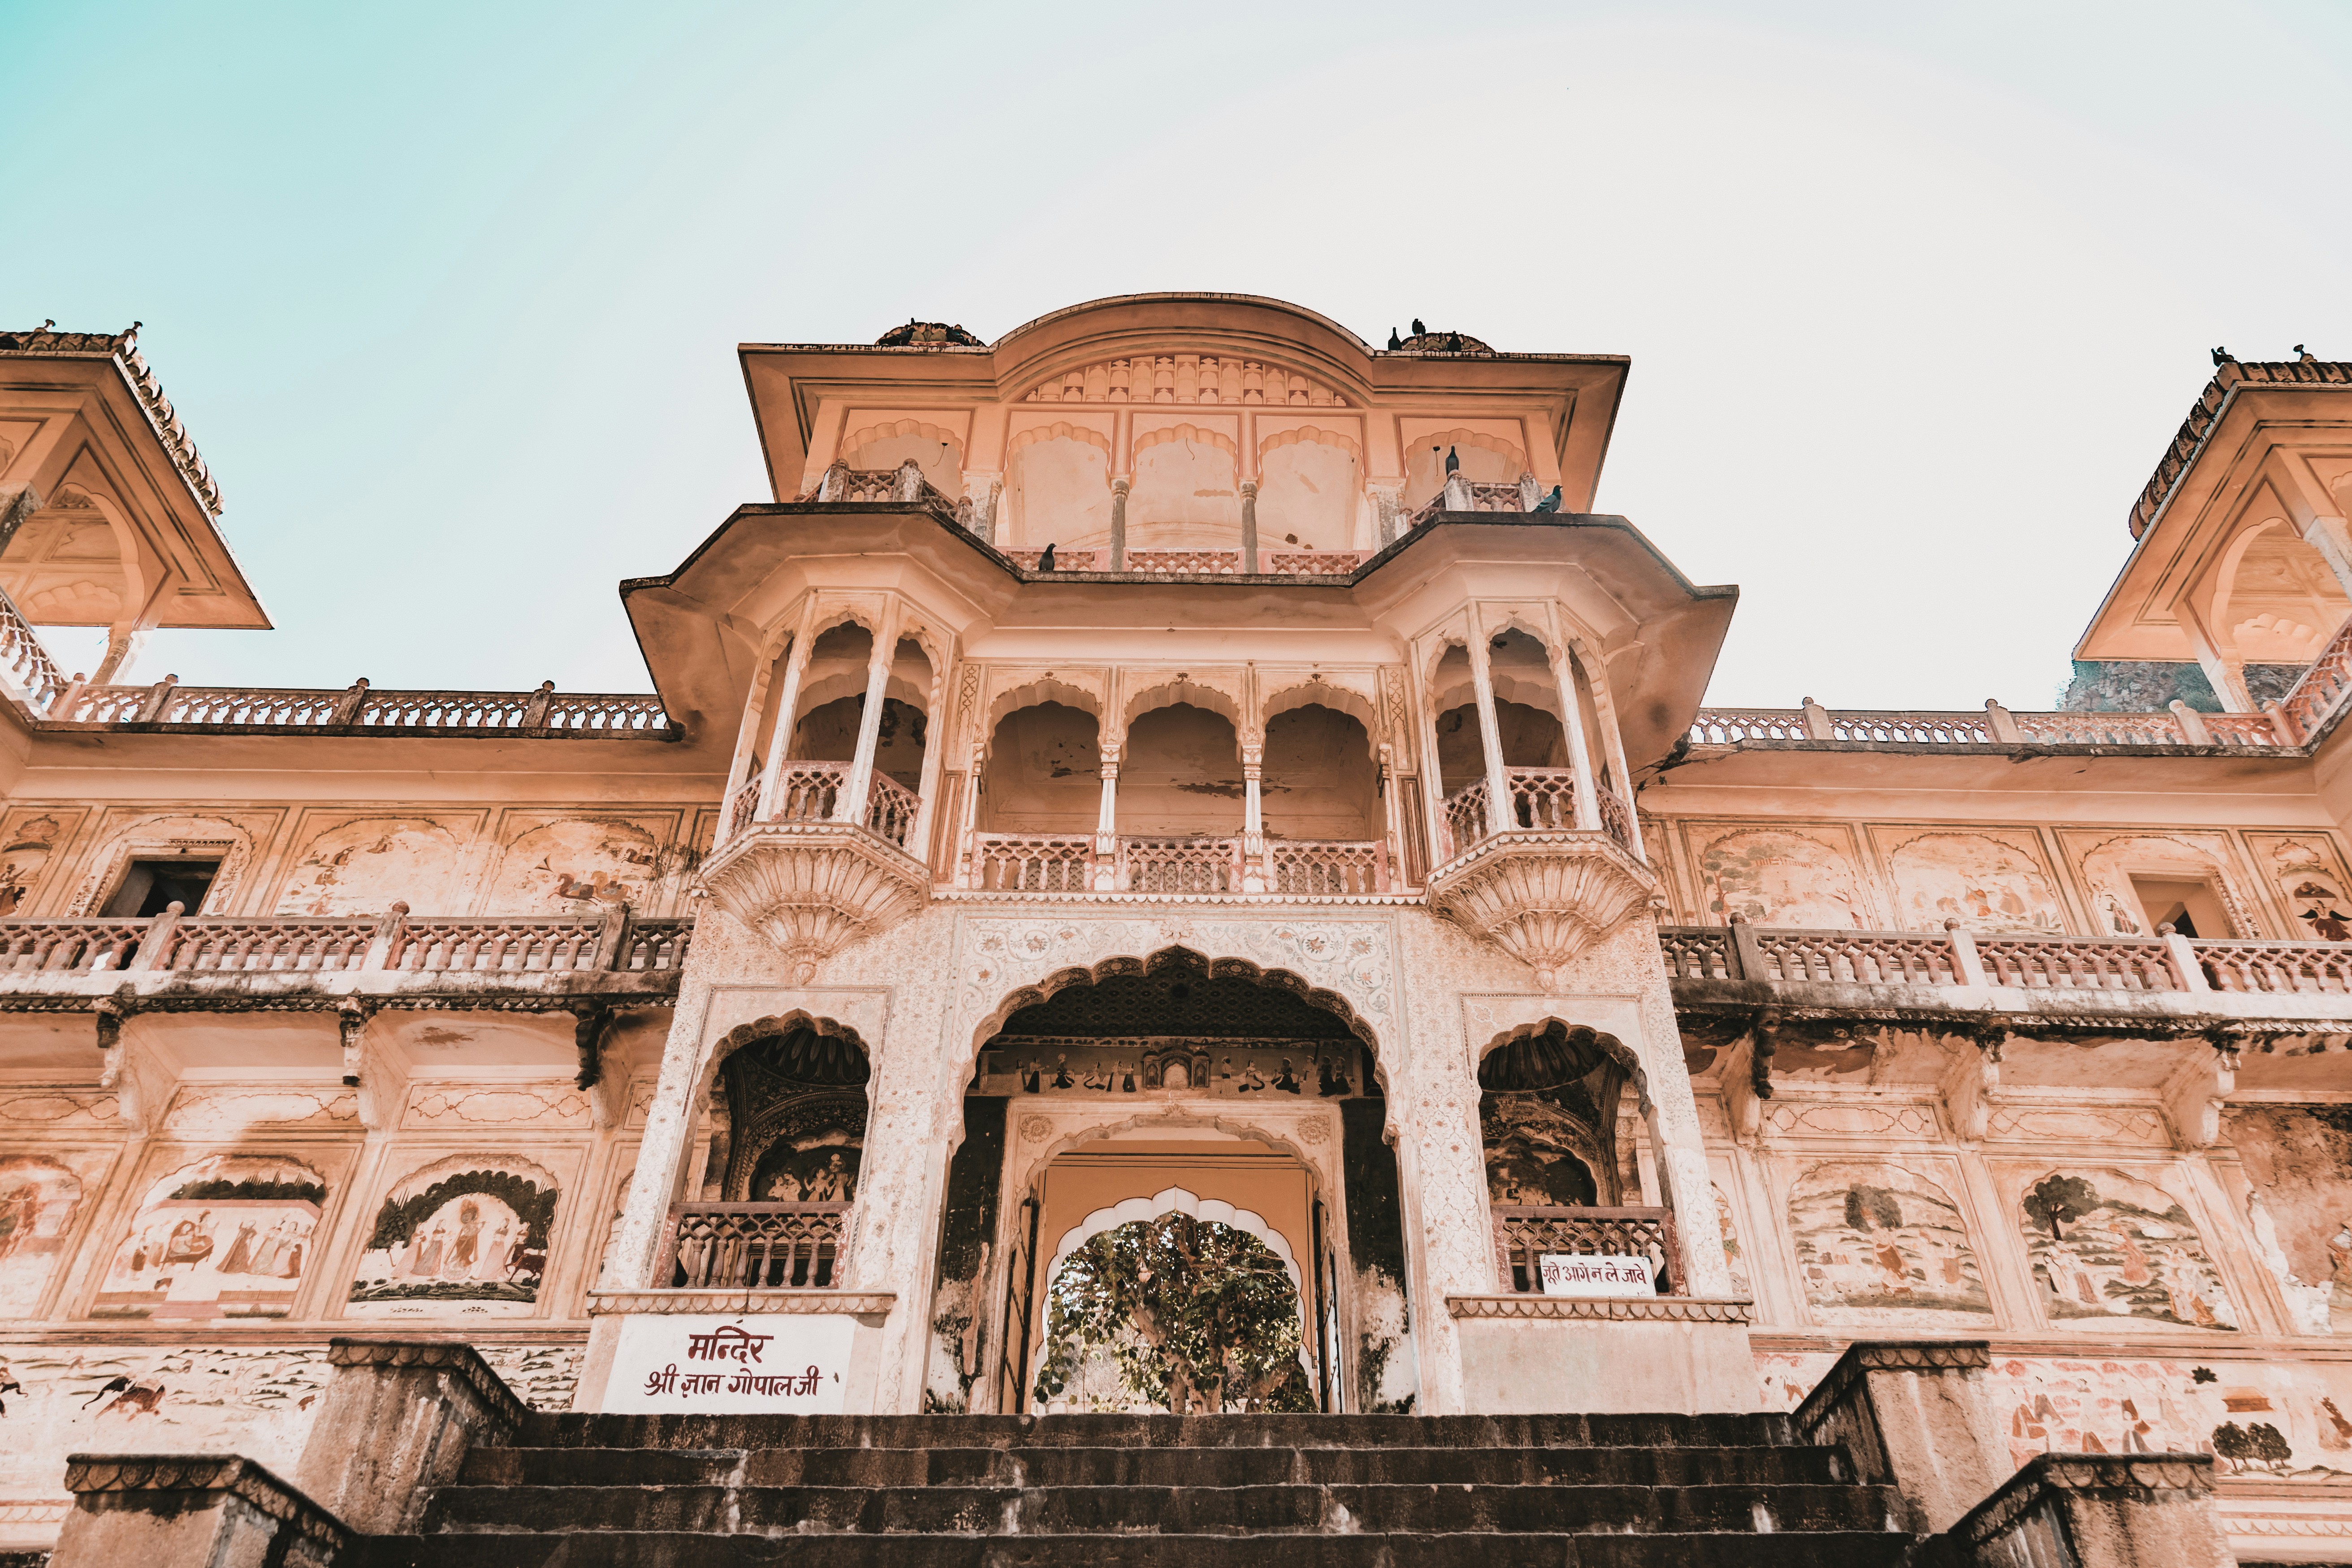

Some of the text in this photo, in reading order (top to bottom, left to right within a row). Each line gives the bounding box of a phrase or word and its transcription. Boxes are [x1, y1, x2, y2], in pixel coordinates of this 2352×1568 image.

[1542, 1261, 1647, 1285] जूते आगे न ले जावे
[644, 1363, 680, 1396] श्री
[681, 1374, 726, 1398] ज्ञान
